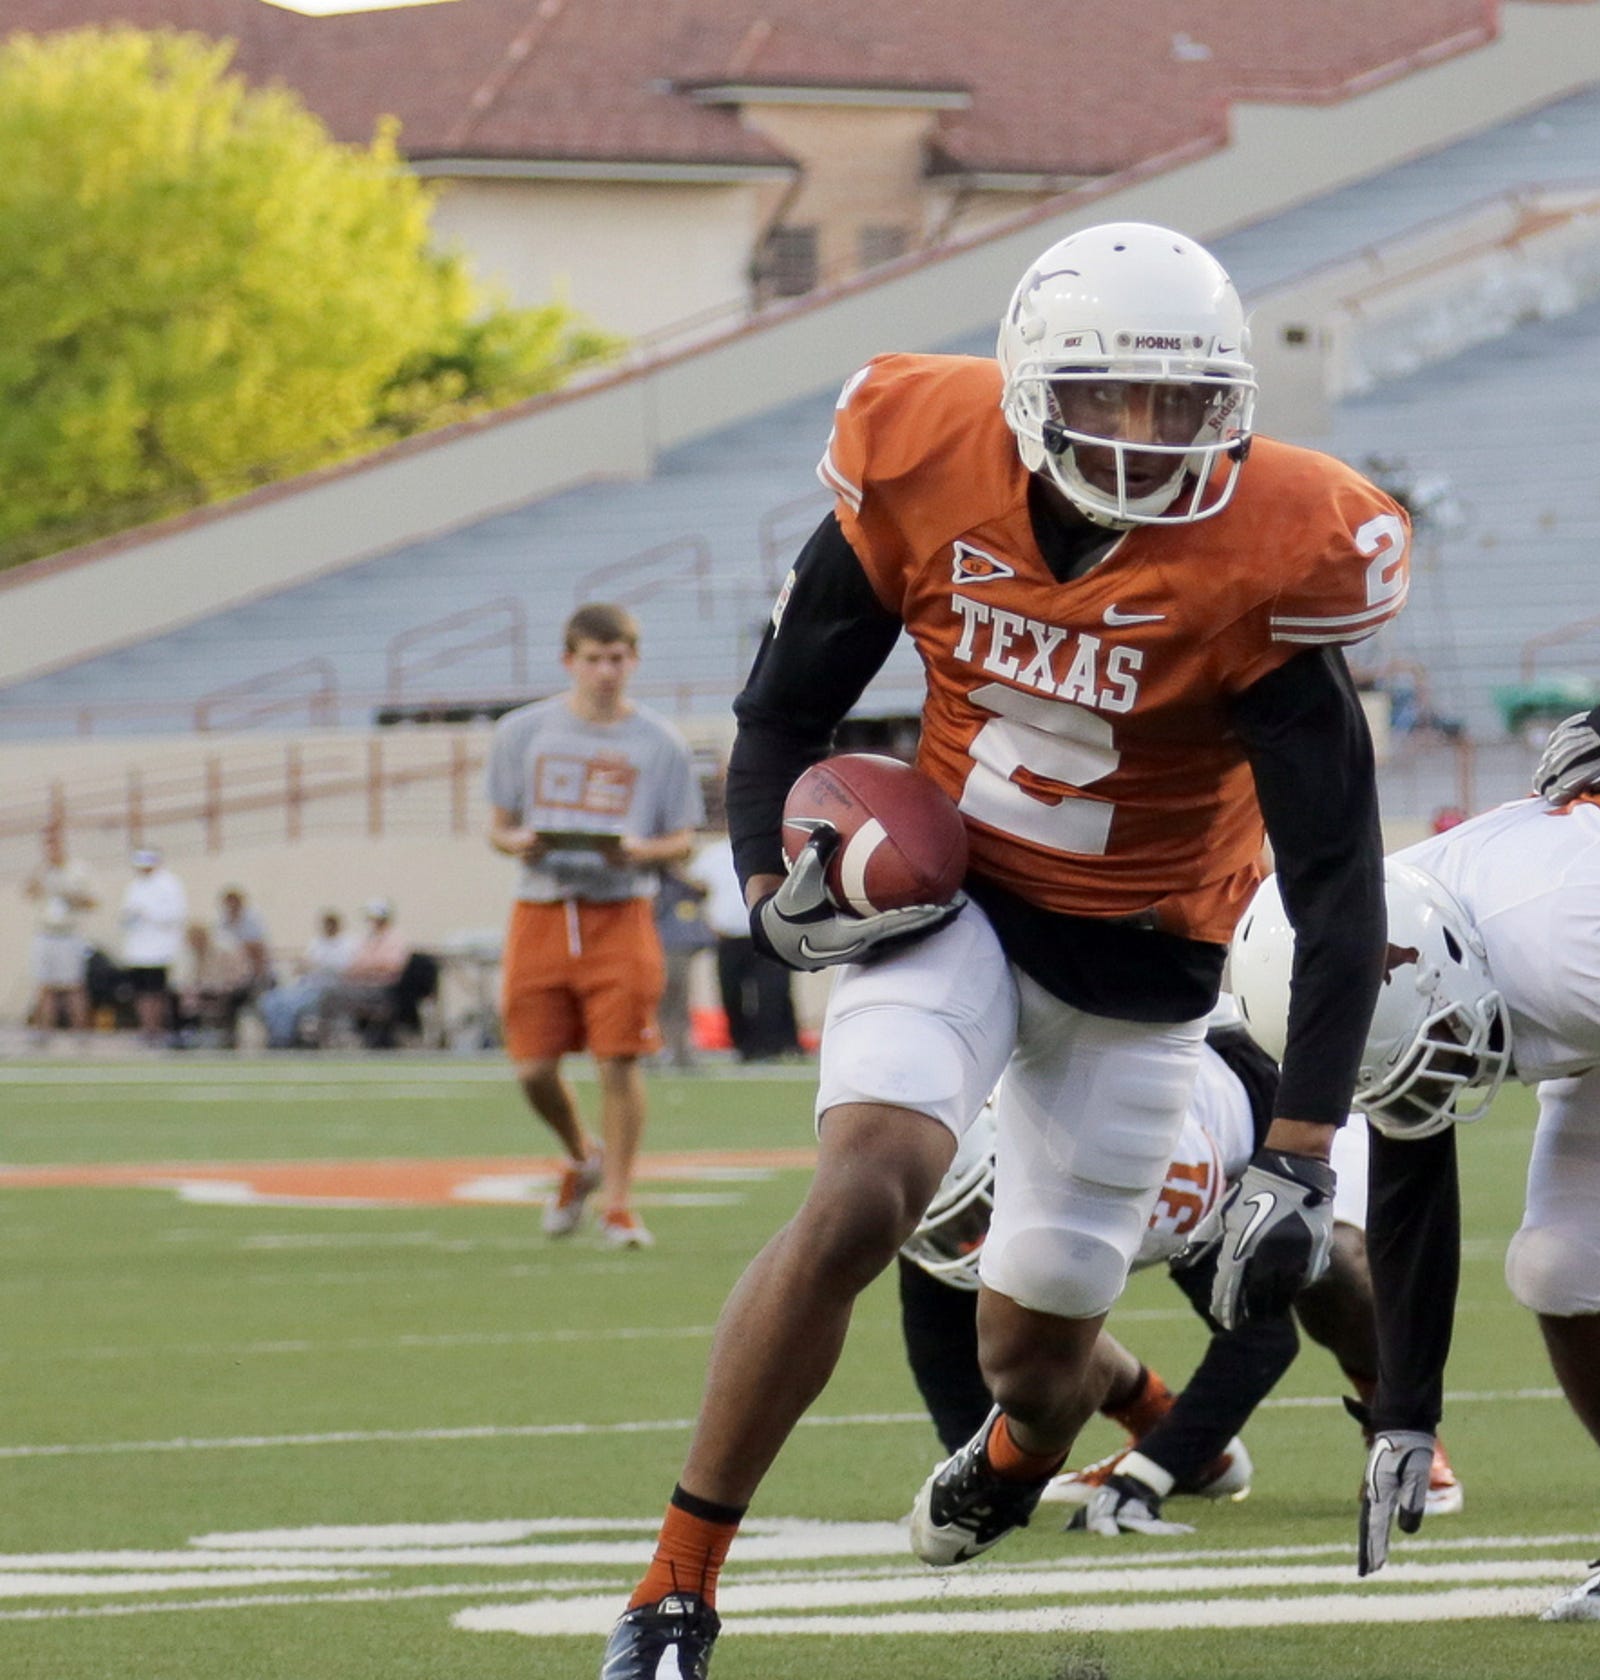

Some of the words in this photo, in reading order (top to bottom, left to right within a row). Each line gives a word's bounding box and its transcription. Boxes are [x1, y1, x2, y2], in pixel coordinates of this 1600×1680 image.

[1135, 336, 1181, 350] HORNS
[1355, 513, 1405, 608] 2
[951, 593, 1144, 714] TEXAS
[957, 682, 1122, 856] 2
